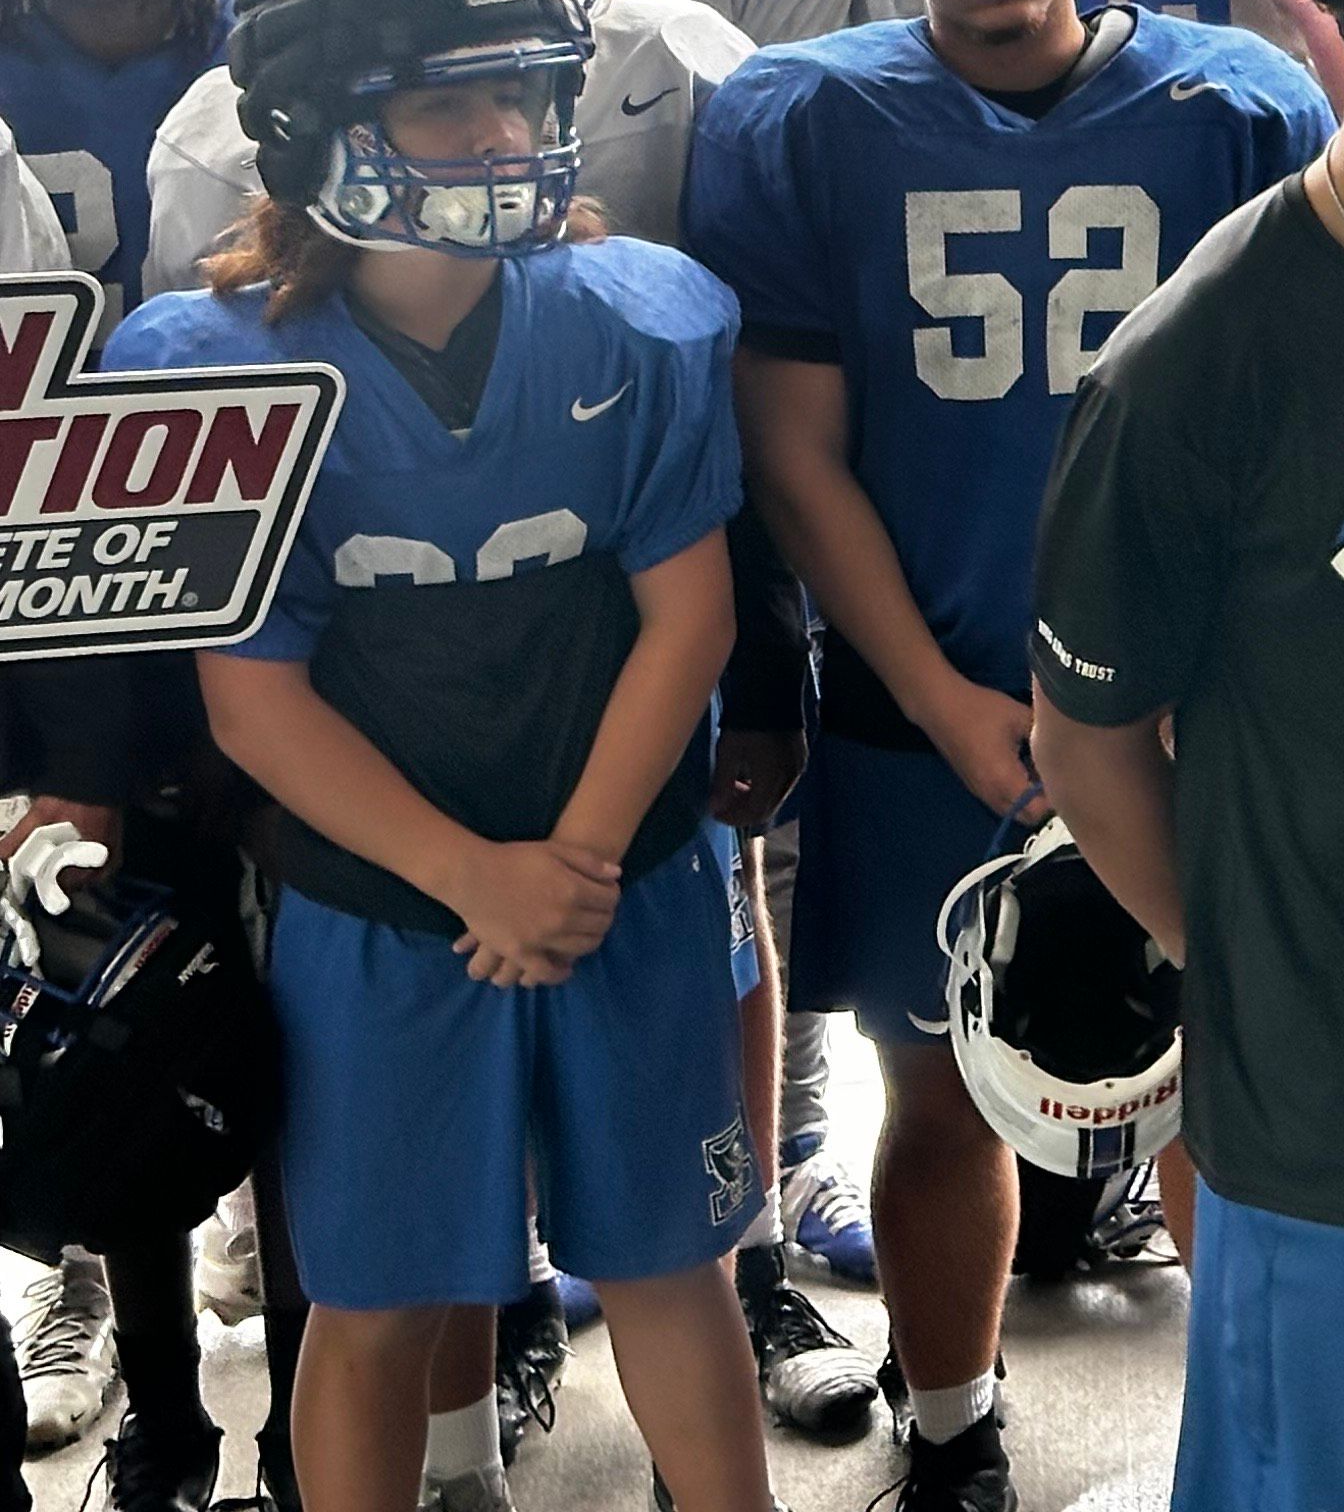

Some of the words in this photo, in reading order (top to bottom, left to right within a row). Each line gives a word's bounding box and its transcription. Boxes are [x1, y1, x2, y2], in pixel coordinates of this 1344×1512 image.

[905, 184, 1161, 401] 52
[0, 402, 304, 516] TION
[93, 520, 179, 566] OF
